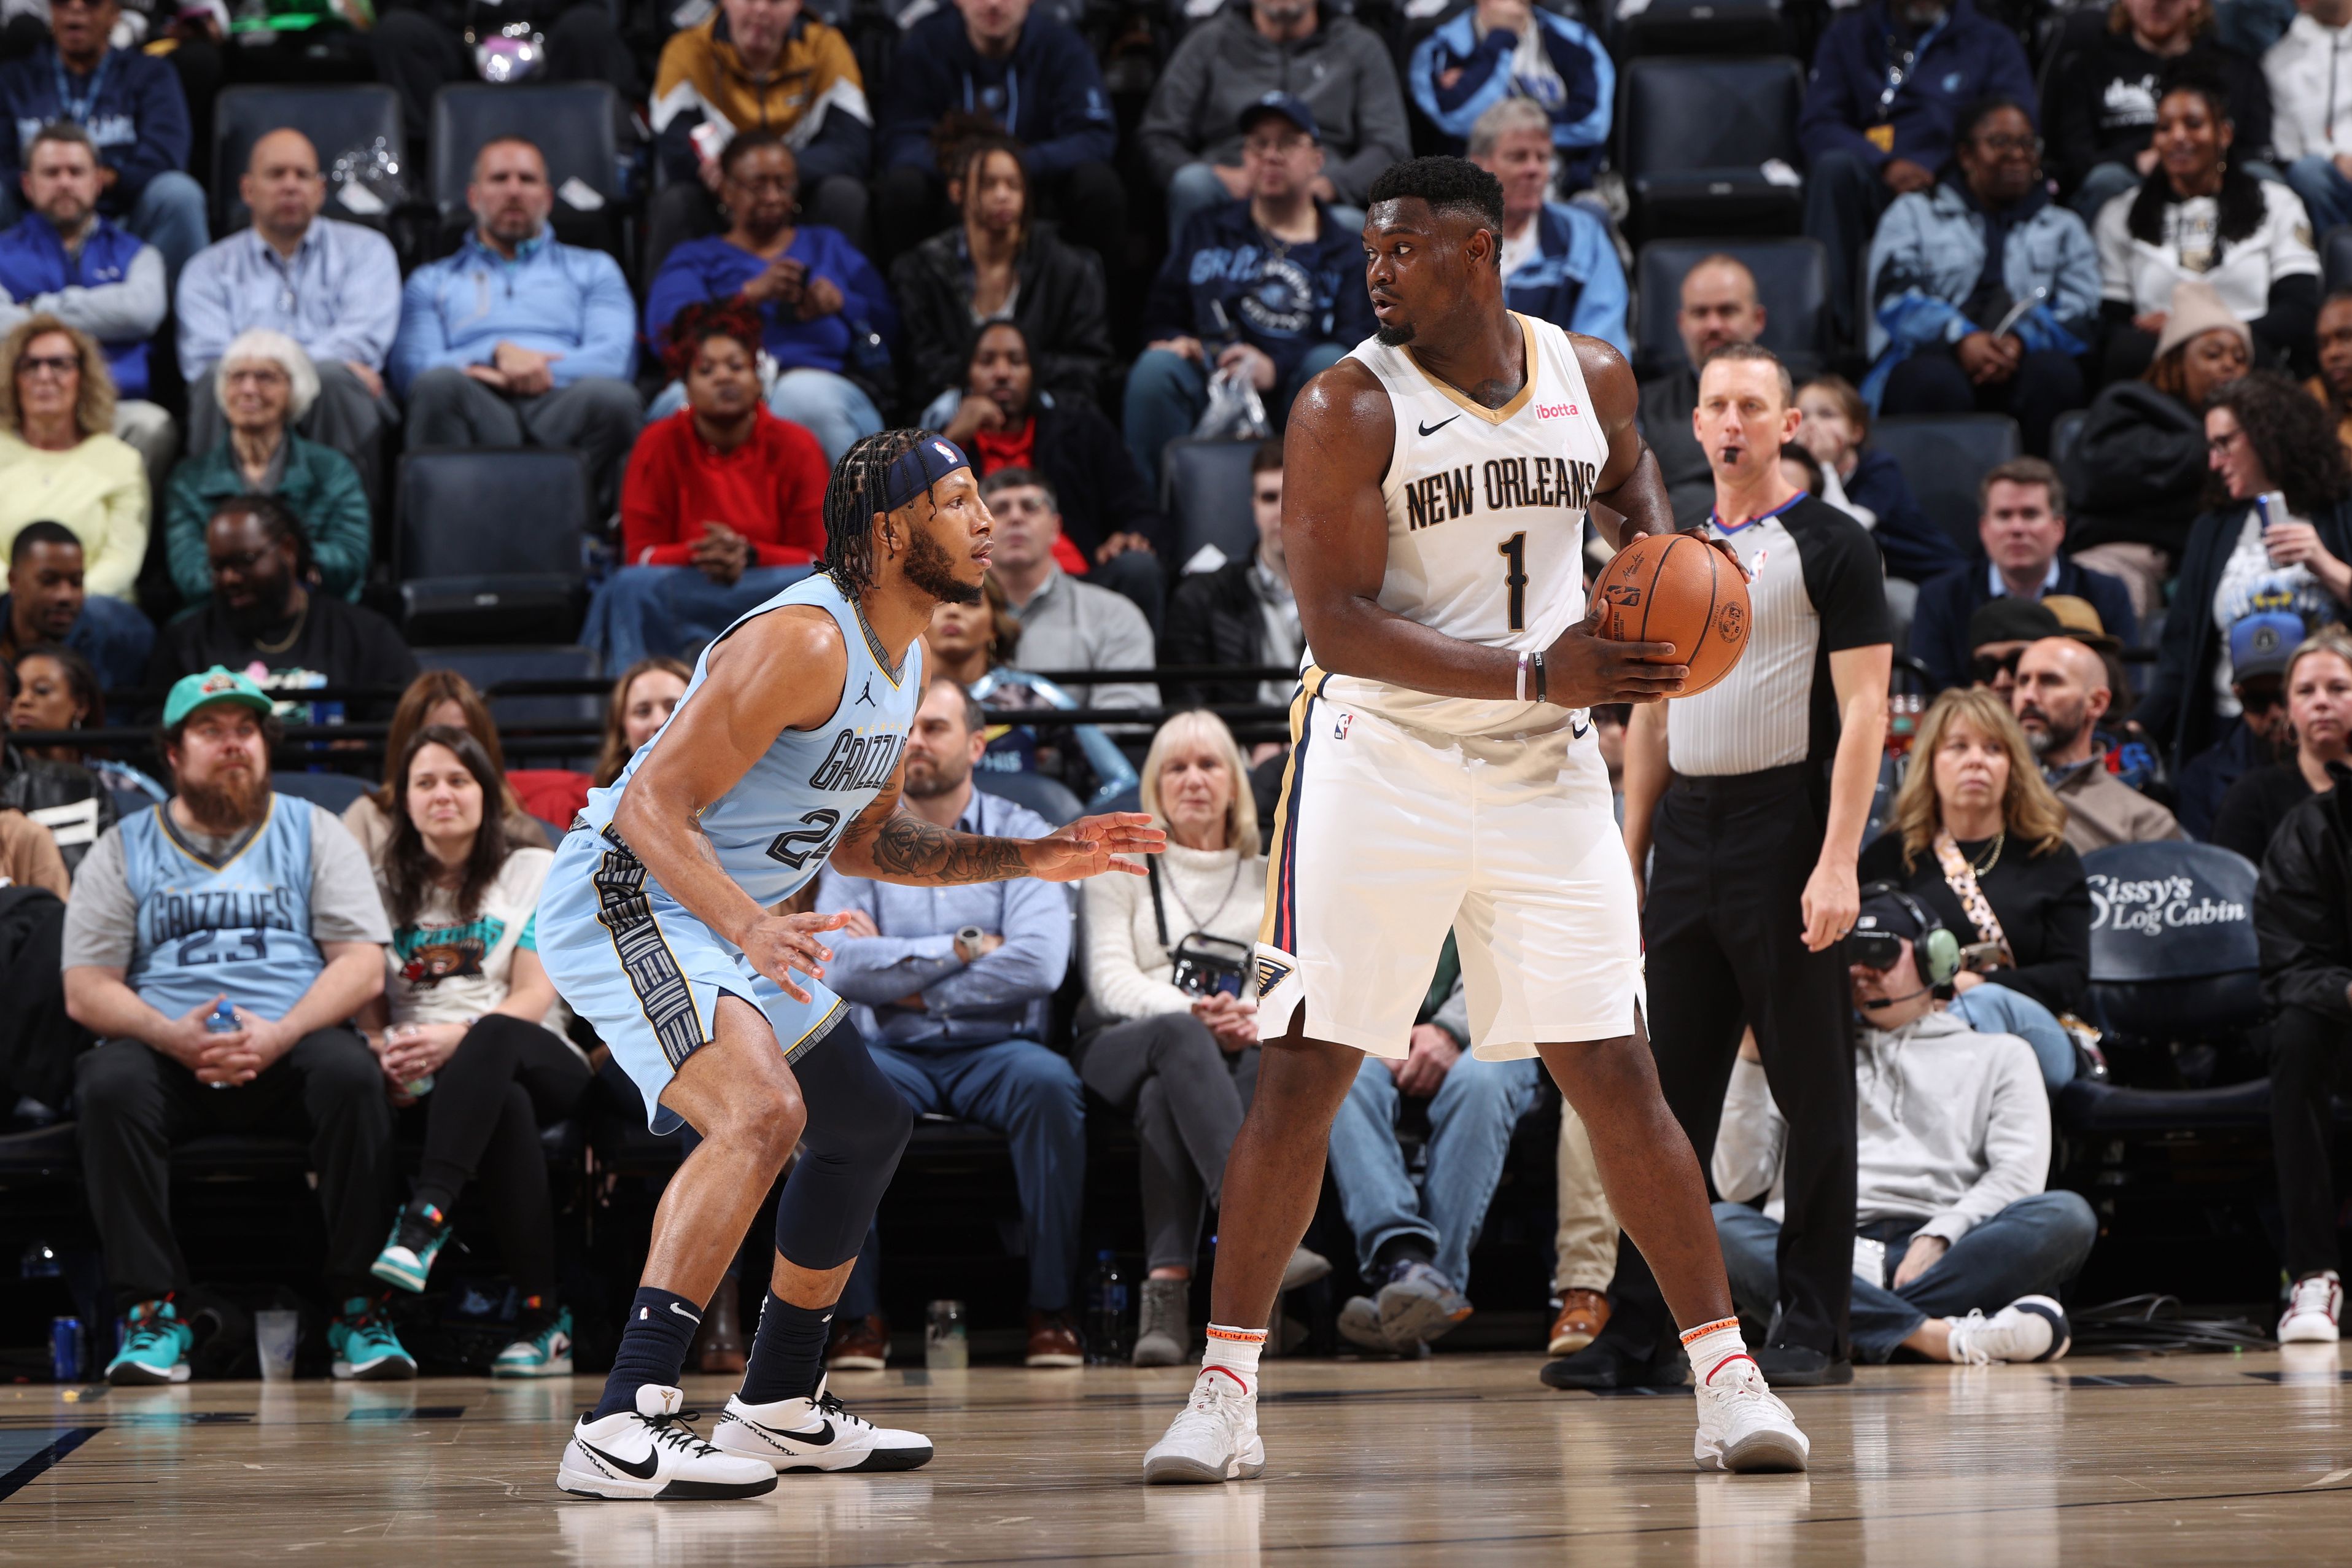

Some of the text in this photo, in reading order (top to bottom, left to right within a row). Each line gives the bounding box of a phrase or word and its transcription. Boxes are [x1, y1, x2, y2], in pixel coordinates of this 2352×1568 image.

[1535, 403, 1578, 419] ibotta
[1405, 456, 1596, 532] NEW ORLEANS
[1497, 530, 1529, 633] 1
[809, 728, 907, 791] GRIZZLI
[151, 886, 294, 944] GRIZZLIES
[2086, 874, 2194, 931] Sissy's
[2111, 897, 2246, 937] Log Cabin
[177, 928, 267, 967] 23
